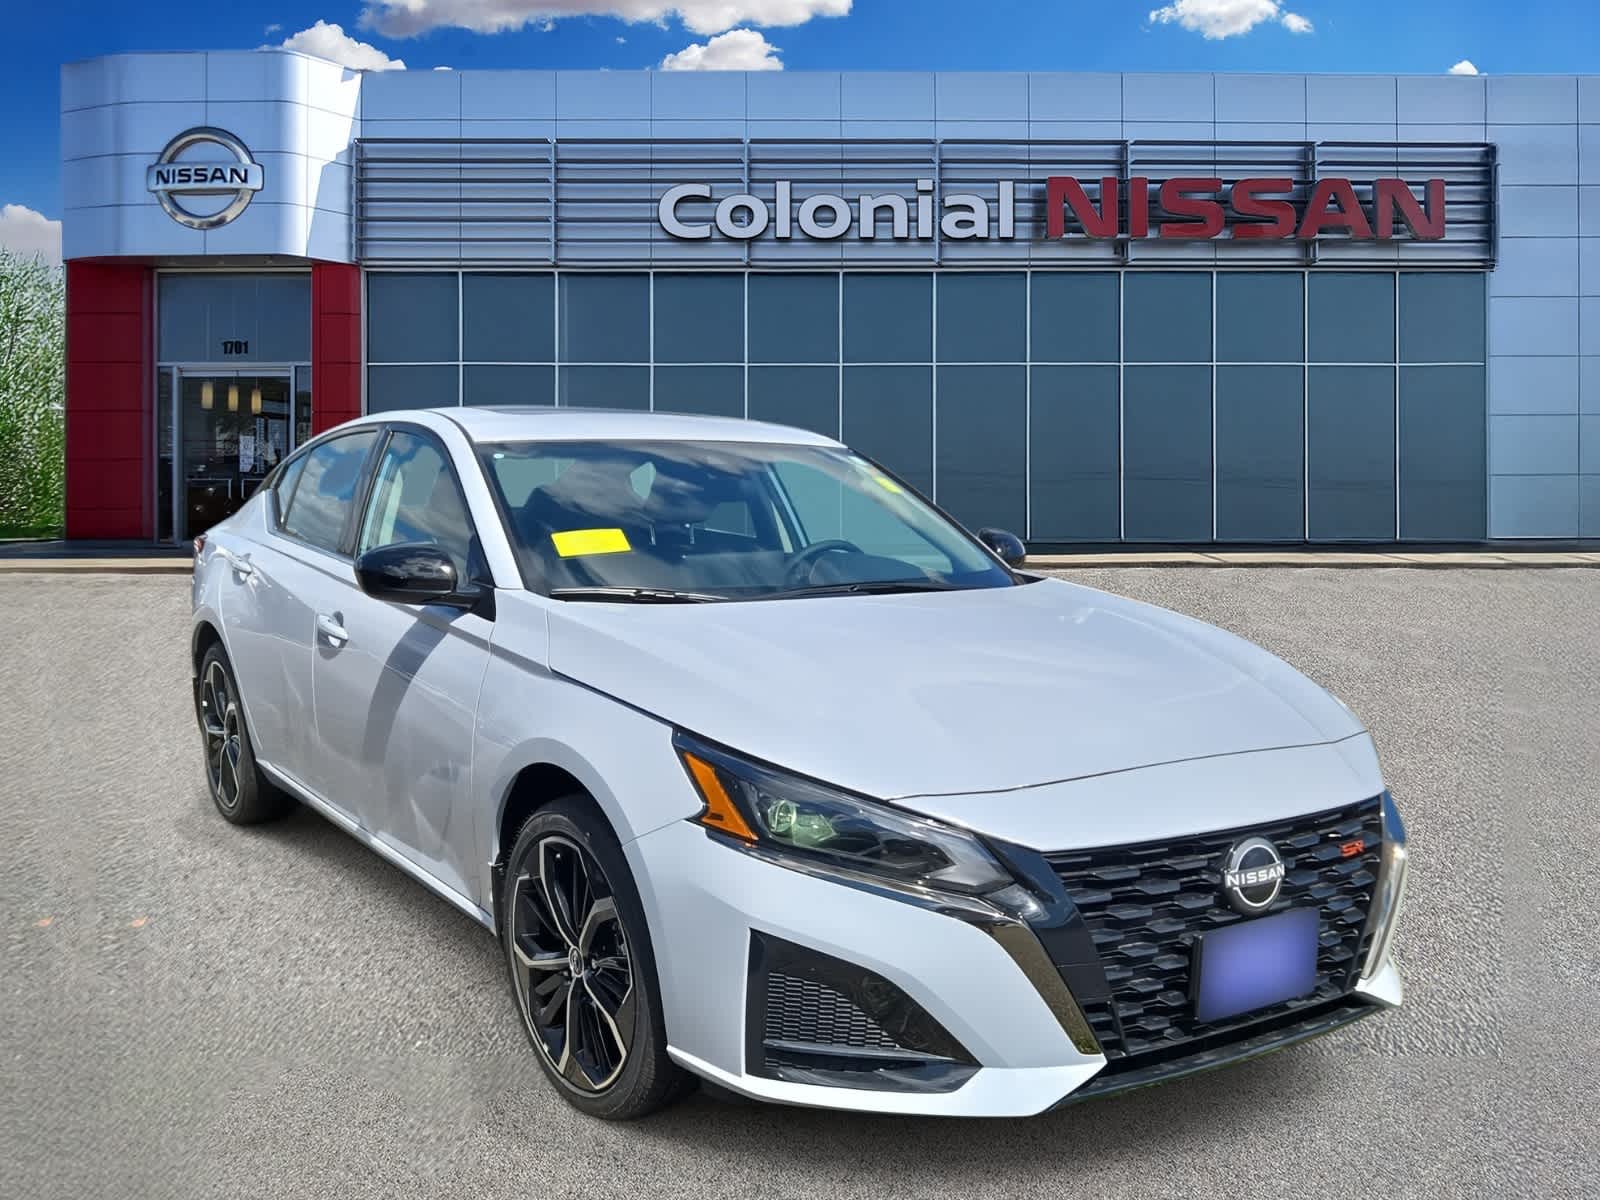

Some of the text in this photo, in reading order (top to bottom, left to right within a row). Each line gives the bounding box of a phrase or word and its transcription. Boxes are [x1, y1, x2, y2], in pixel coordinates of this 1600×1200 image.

[156, 167, 249, 185] NISSAN
[657, 176, 1447, 241] Colonial NISSAN
[221, 340, 249, 354] 1701
[1226, 864, 1285, 887] NISSAN
